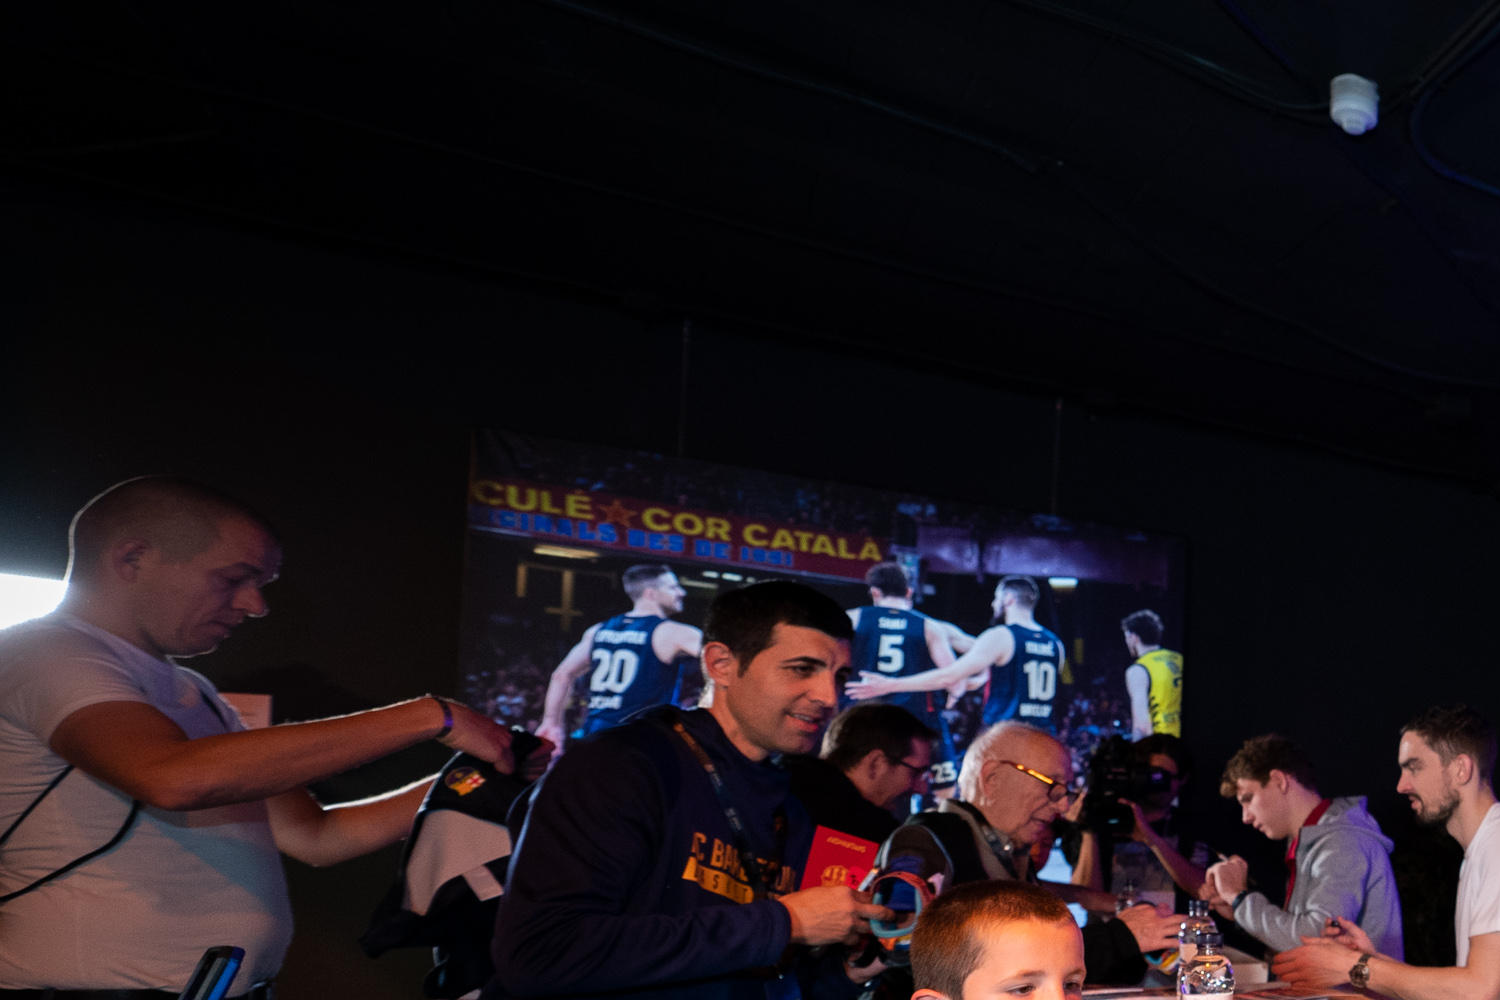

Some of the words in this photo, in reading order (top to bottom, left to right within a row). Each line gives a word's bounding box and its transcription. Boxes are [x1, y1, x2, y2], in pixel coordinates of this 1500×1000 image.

[641, 507, 732, 541] COR
[590, 648, 640, 694] 20
[877, 634, 905, 673] 5
[1023, 660, 1057, 701] 10
